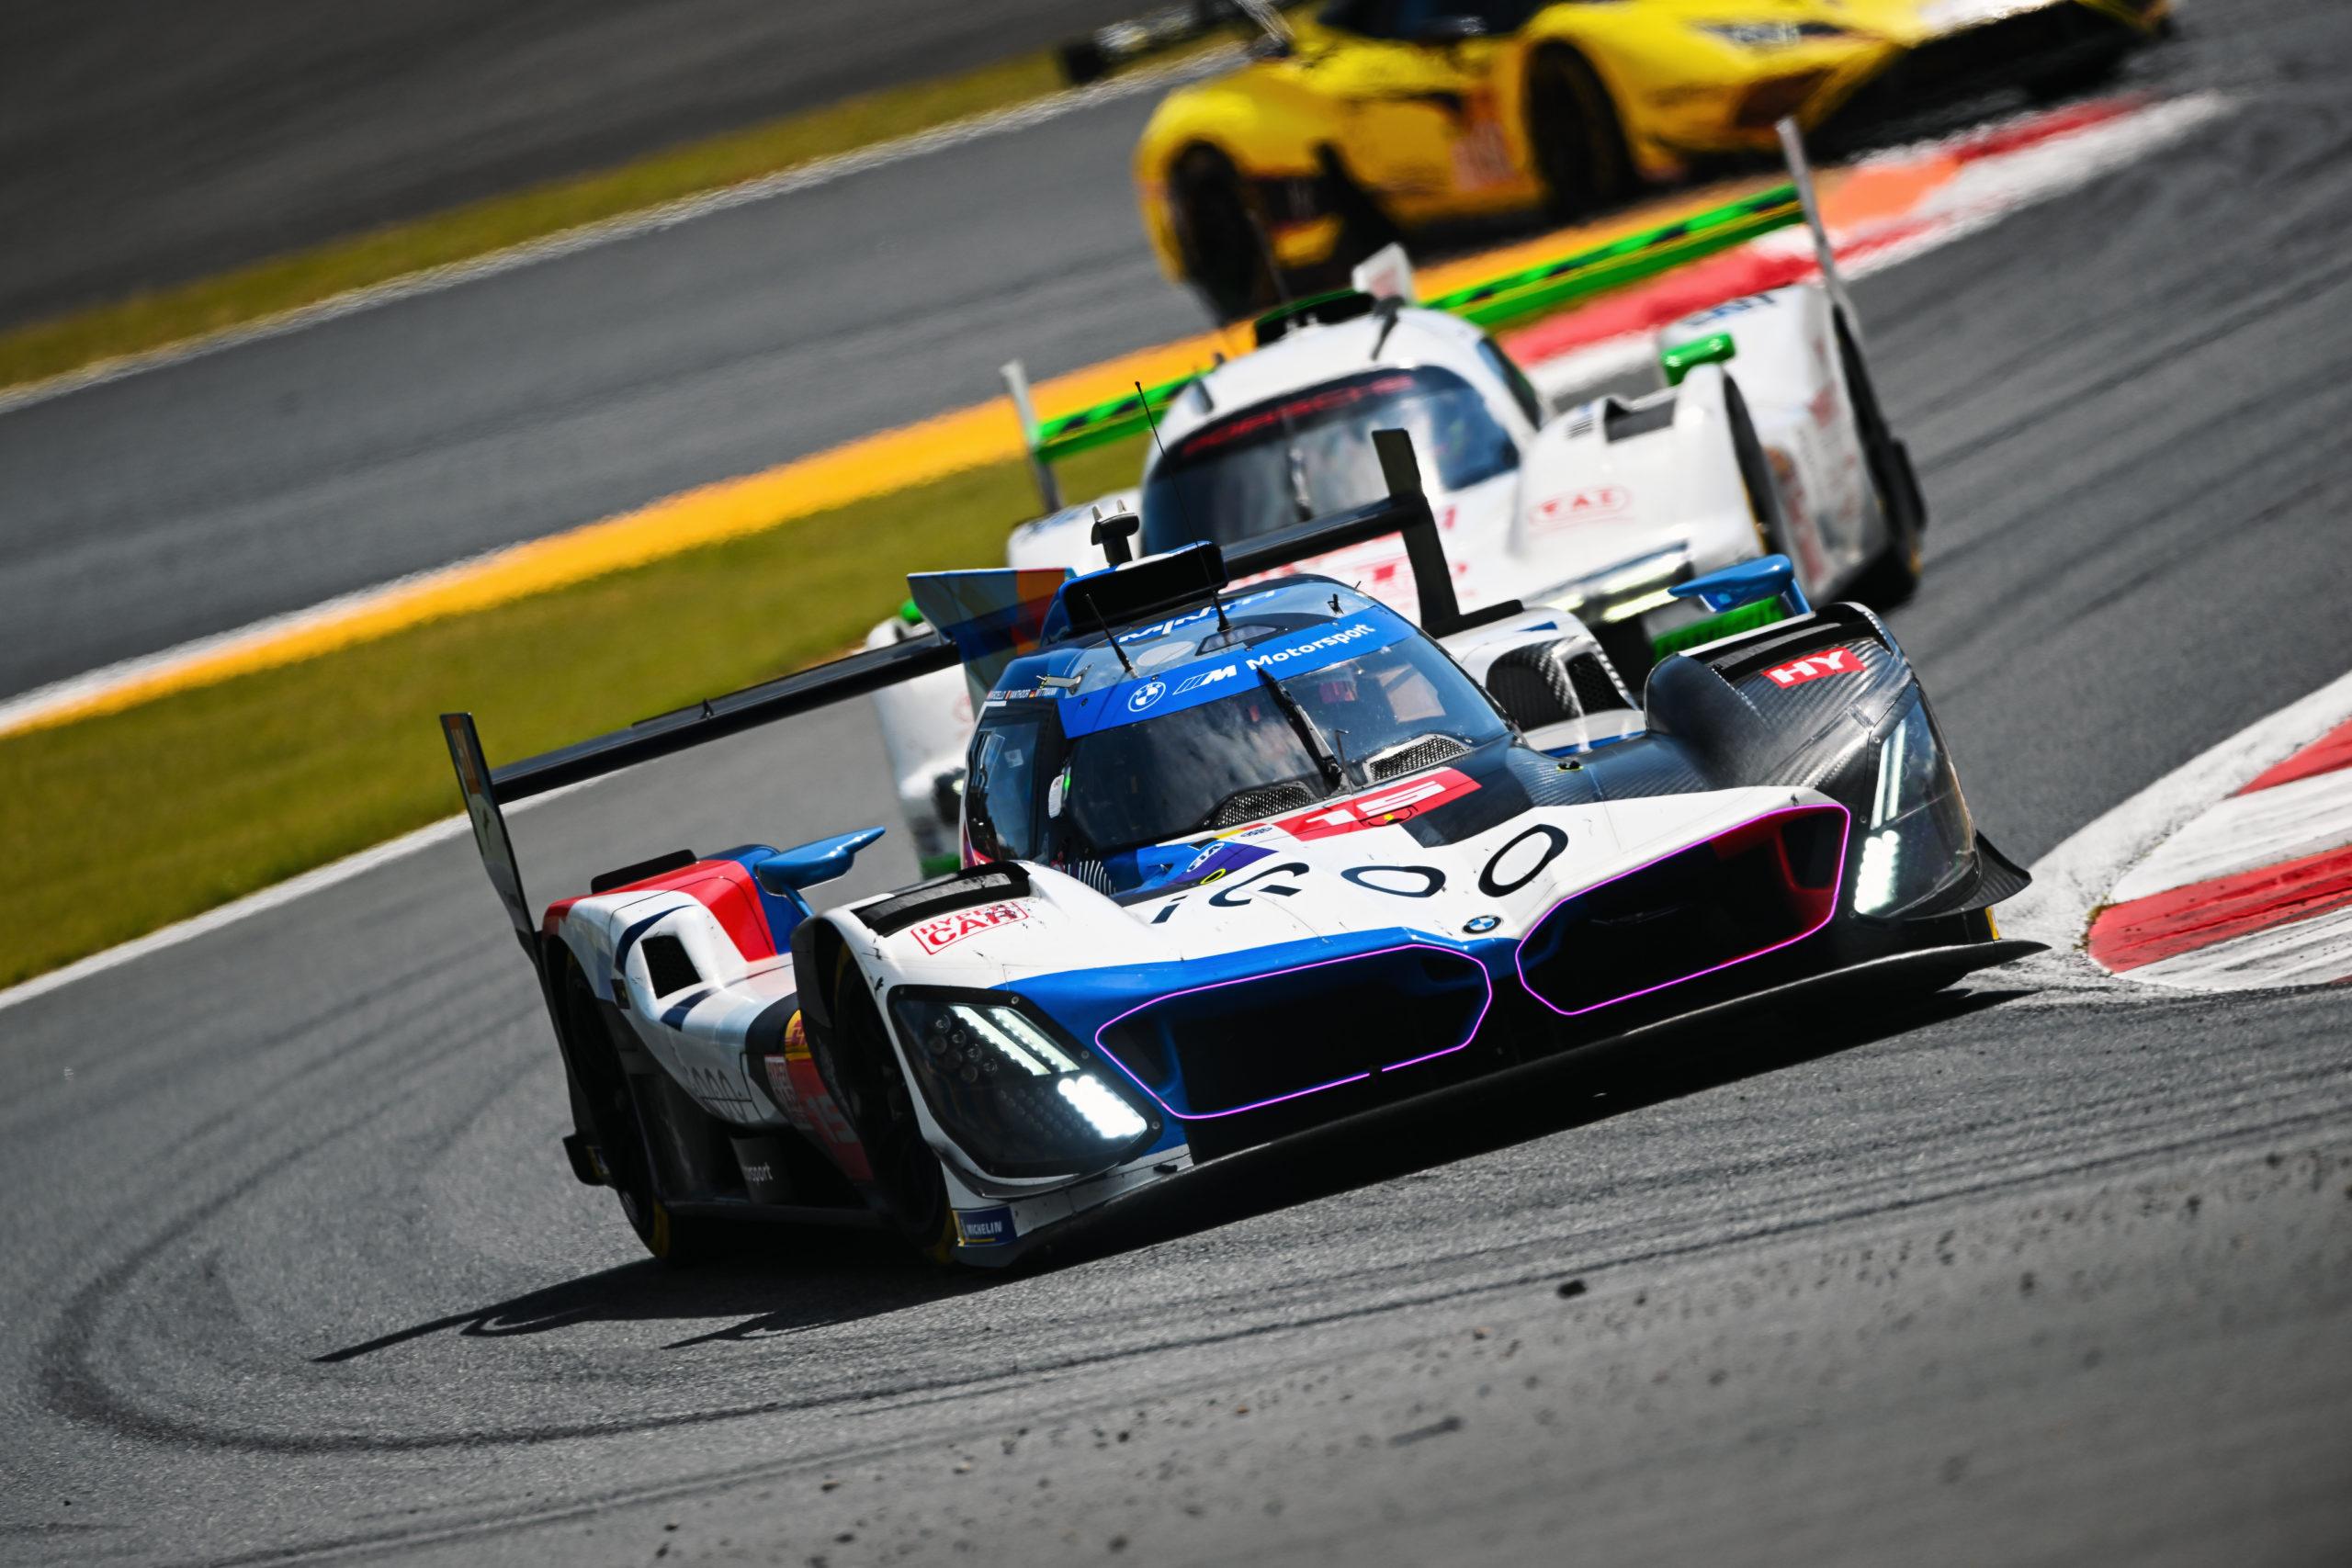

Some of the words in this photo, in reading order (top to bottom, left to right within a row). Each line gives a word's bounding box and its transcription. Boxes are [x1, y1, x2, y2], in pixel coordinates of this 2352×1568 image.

[1245, 623, 1376, 671] Motorsport
[1770, 650, 1845, 683] HY
[1305, 780, 1447, 826] 15
[928, 905, 1018, 946] CAR
[967, 1220, 1003, 1235] MICHELIN
